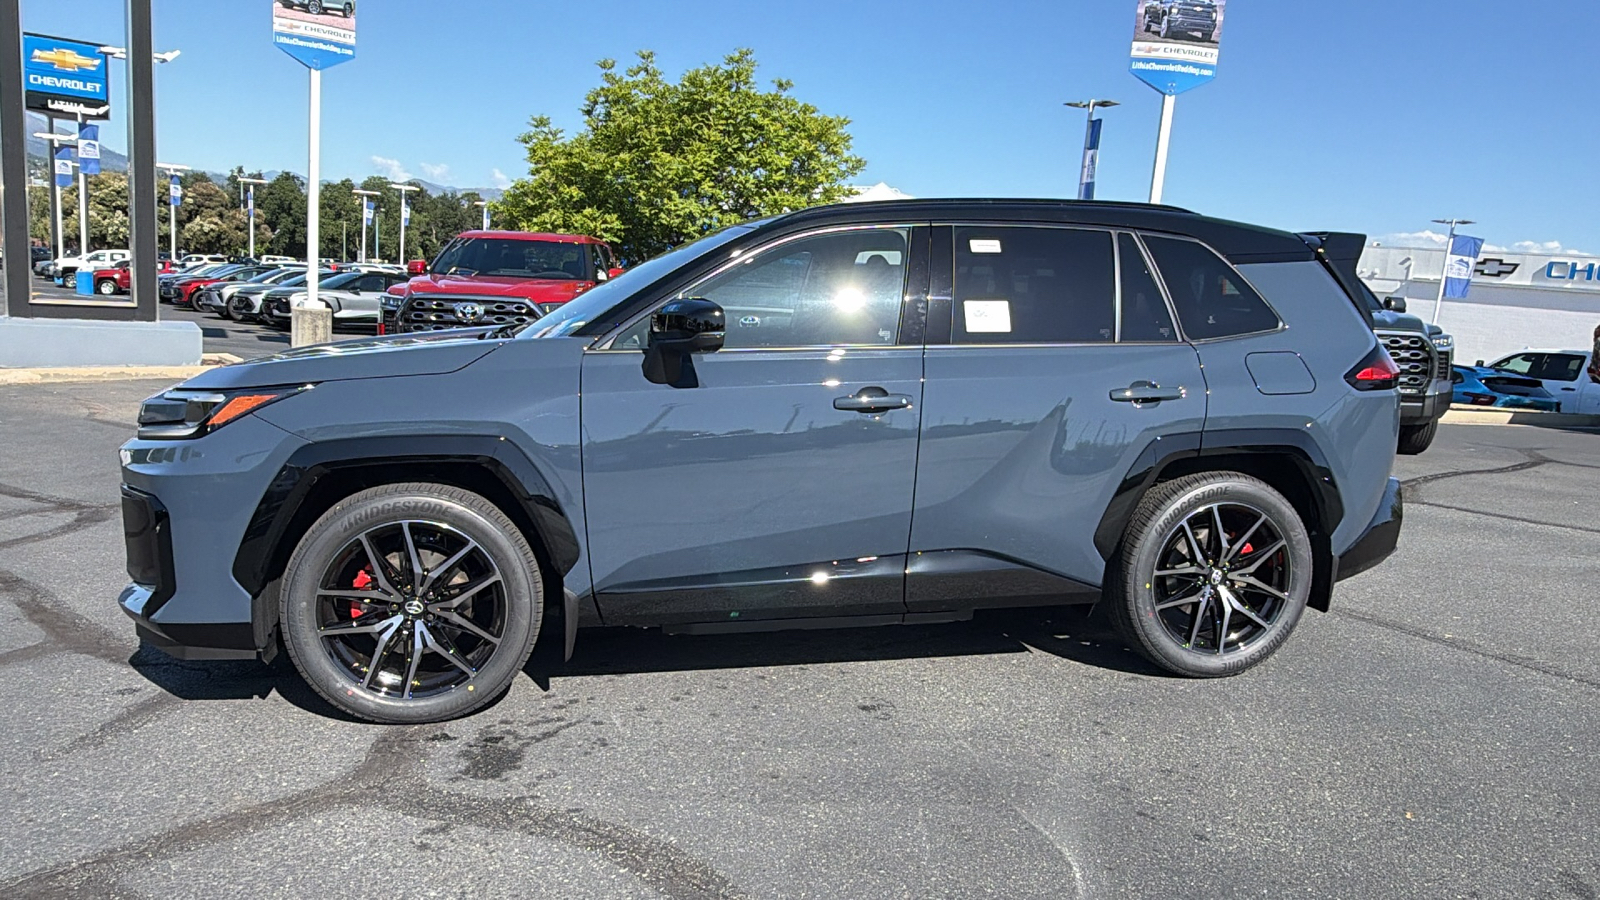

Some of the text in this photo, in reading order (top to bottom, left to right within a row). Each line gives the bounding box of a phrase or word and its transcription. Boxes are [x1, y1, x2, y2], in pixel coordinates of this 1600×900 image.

[304, 25, 352, 39] CHEVROLET
[1163, 46, 1214, 58] CHEVROLET
[29, 74, 102, 93] CHEVROLET
[1546, 261, 1600, 281] CH
[340, 499, 454, 533] BRIDGESTONE
[1154, 486, 1231, 537] BRIDGESTONE
